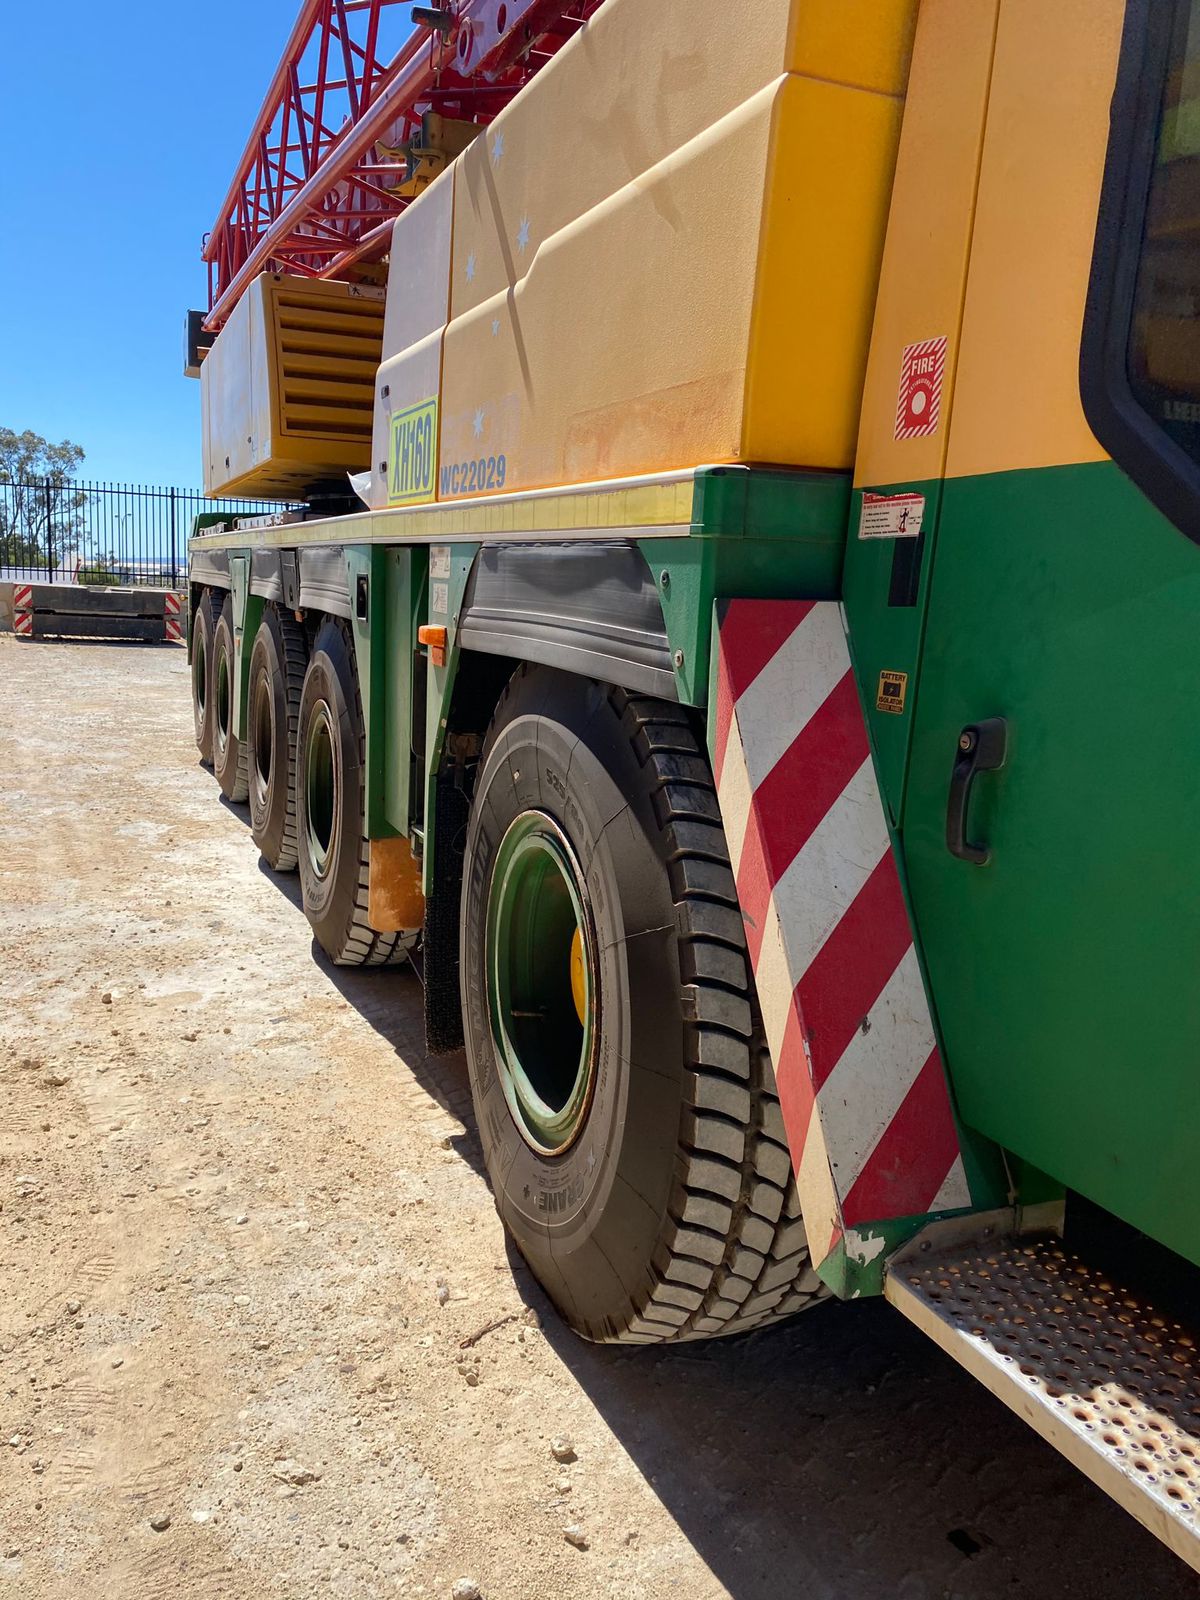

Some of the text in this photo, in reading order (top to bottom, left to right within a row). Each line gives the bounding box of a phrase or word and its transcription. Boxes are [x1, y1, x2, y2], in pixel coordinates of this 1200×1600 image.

[911, 356, 935, 376] FIRE
[393, 413, 432, 494] XH160
[441, 454, 507, 495] WC22029
[881, 672, 906, 682] BATTERY
